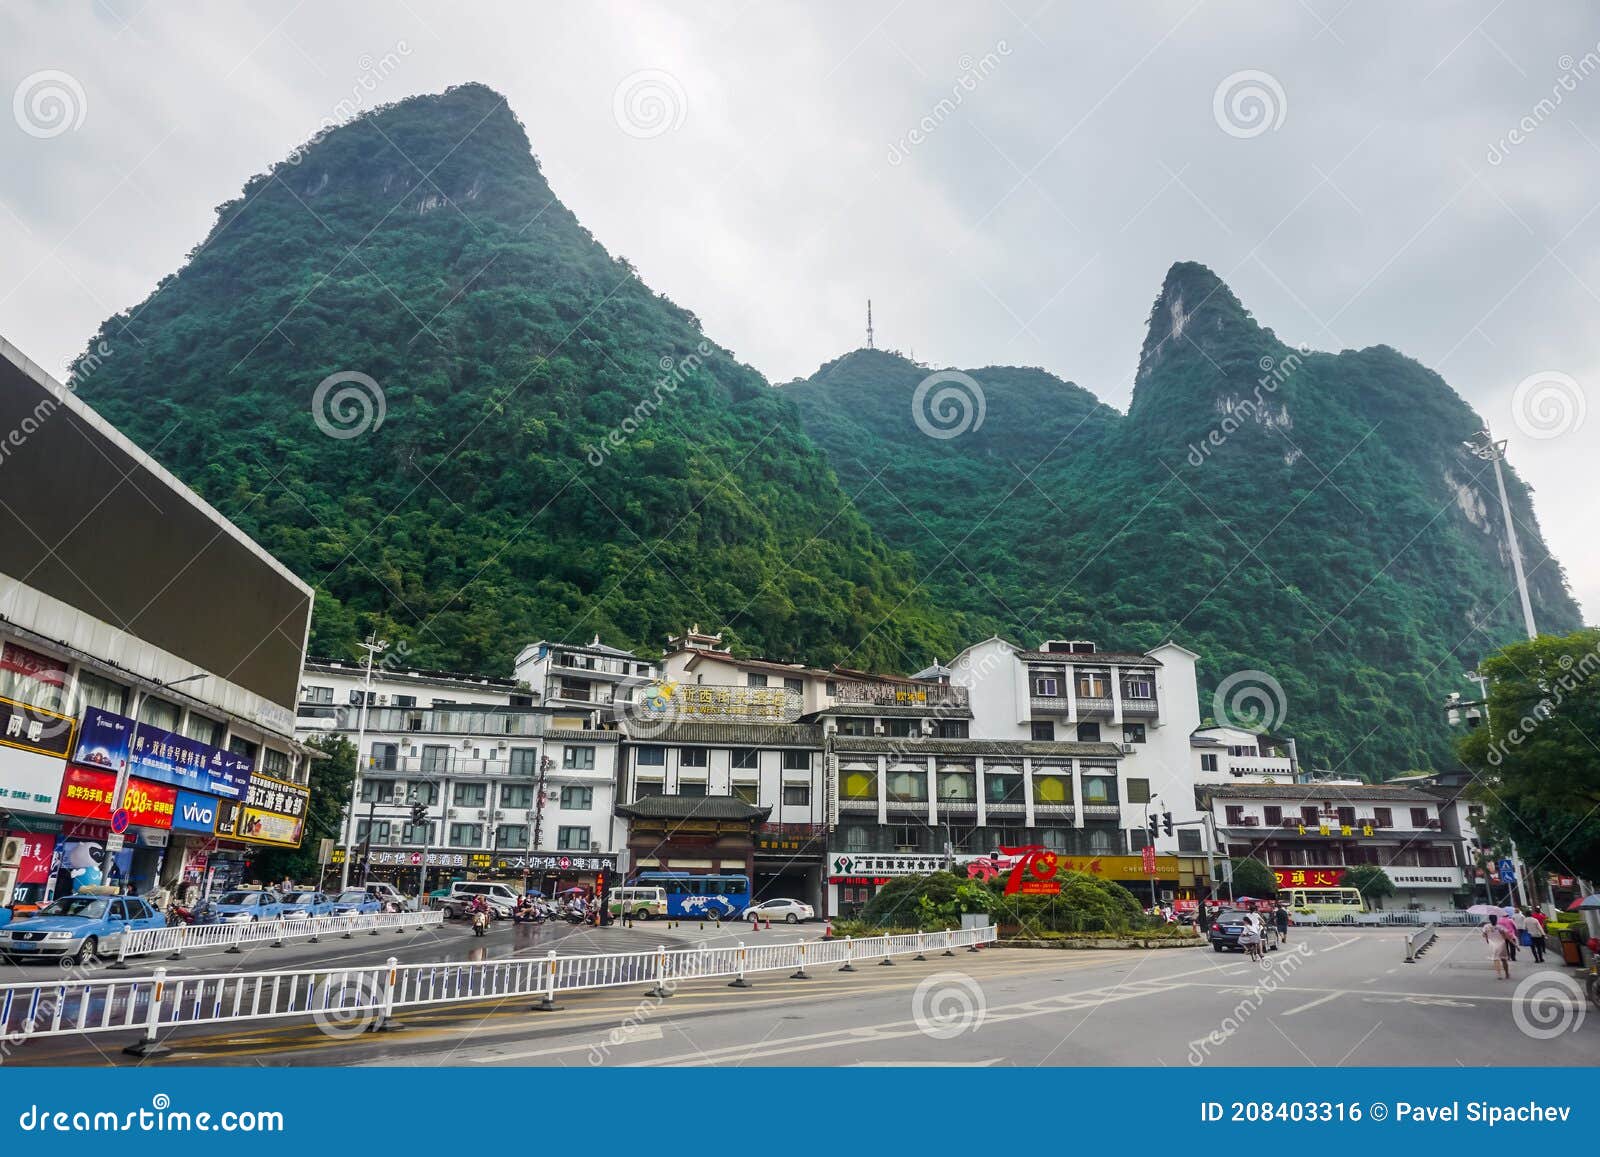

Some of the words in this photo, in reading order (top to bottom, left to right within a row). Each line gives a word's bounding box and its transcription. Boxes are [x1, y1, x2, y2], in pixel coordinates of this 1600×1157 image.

[6, 714, 44, 743] 网吧
[67, 784, 103, 802] 购华为手机
[182, 802, 213, 824] vivo
